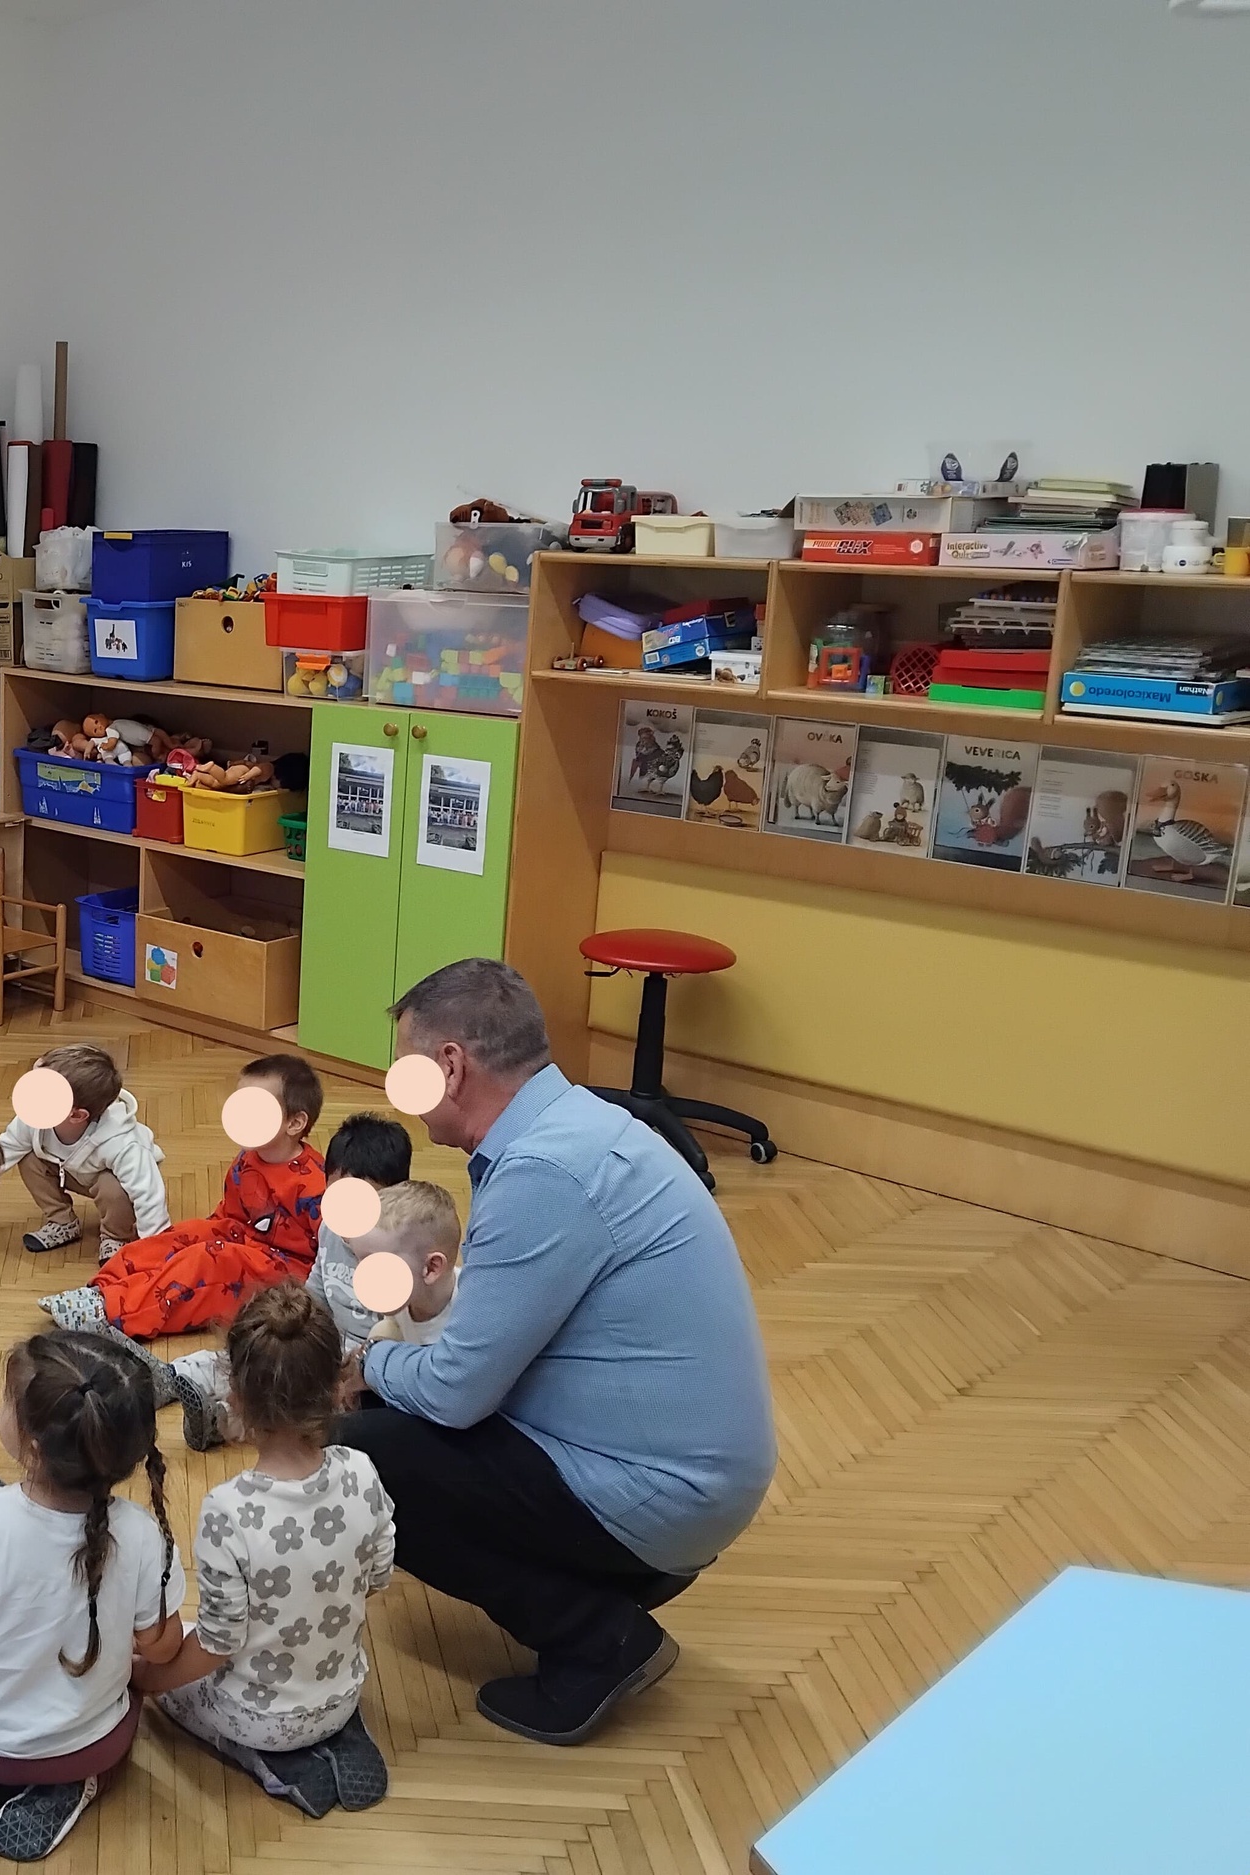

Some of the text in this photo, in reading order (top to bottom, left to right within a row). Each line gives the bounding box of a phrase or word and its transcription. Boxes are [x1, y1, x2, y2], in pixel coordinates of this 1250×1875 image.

[946, 542, 988, 550] Interactive
[1088, 686, 1210, 703] Maxicoloredo Nathan
[646, 708, 677, 719] KOKOŠ
[964, 745, 1021, 761] VEVERICA
